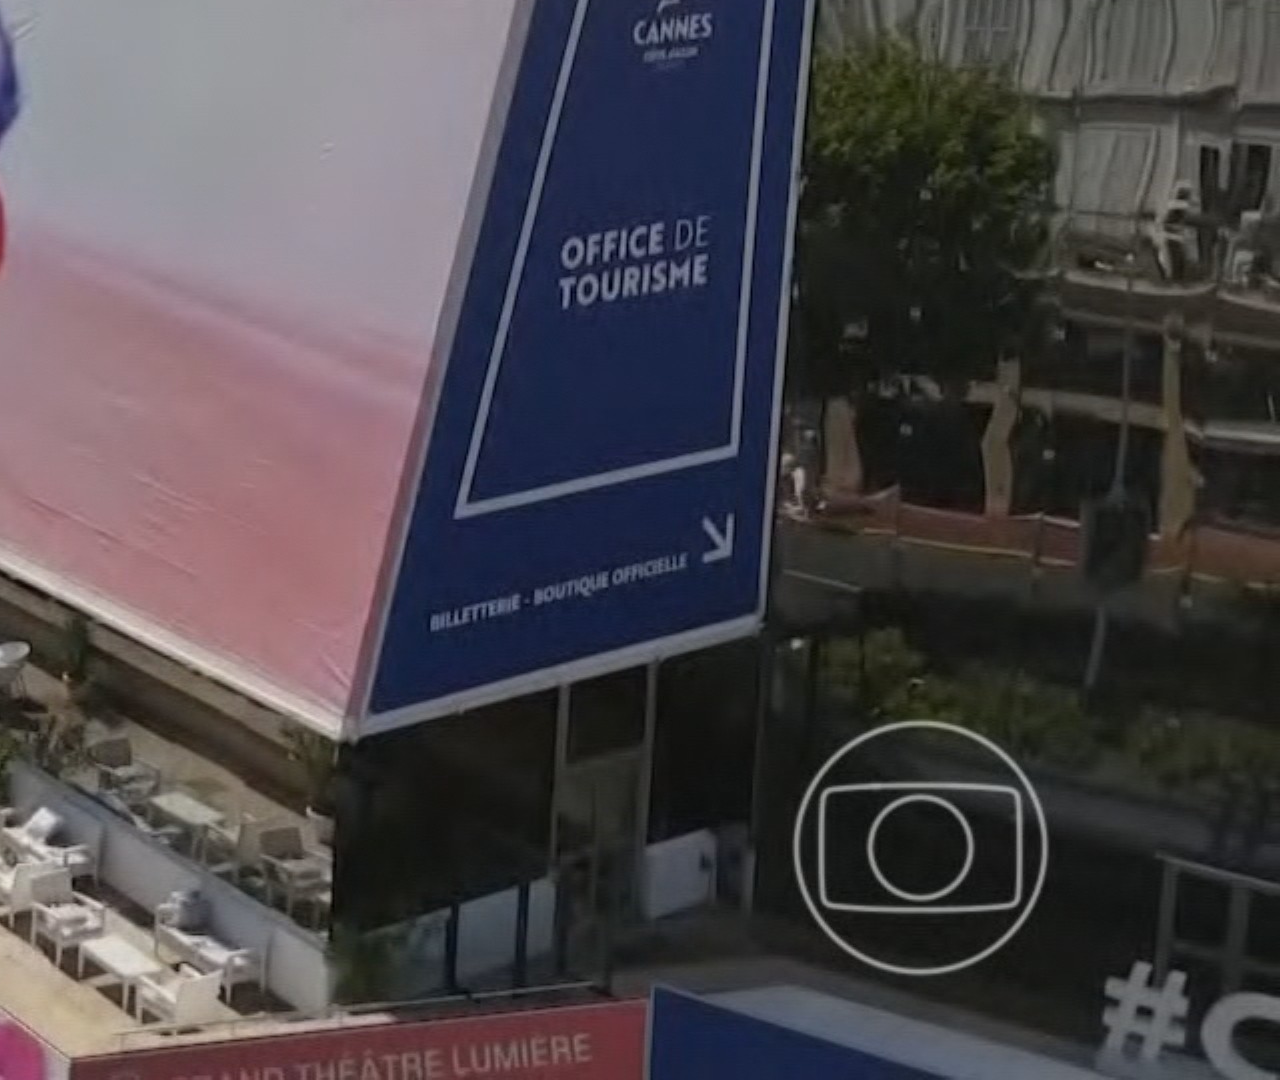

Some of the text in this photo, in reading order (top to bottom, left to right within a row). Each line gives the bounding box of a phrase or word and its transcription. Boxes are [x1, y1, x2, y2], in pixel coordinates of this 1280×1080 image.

[633, 12, 713, 45] CANNES
[560, 214, 712, 270] OFFICE DE
[558, 252, 709, 310] TOURISME
[429, 592, 522, 633] BILLETTERIE
[533, 570, 610, 606] BOUTIQUE
[611, 551, 689, 587] OFFICIELLE
